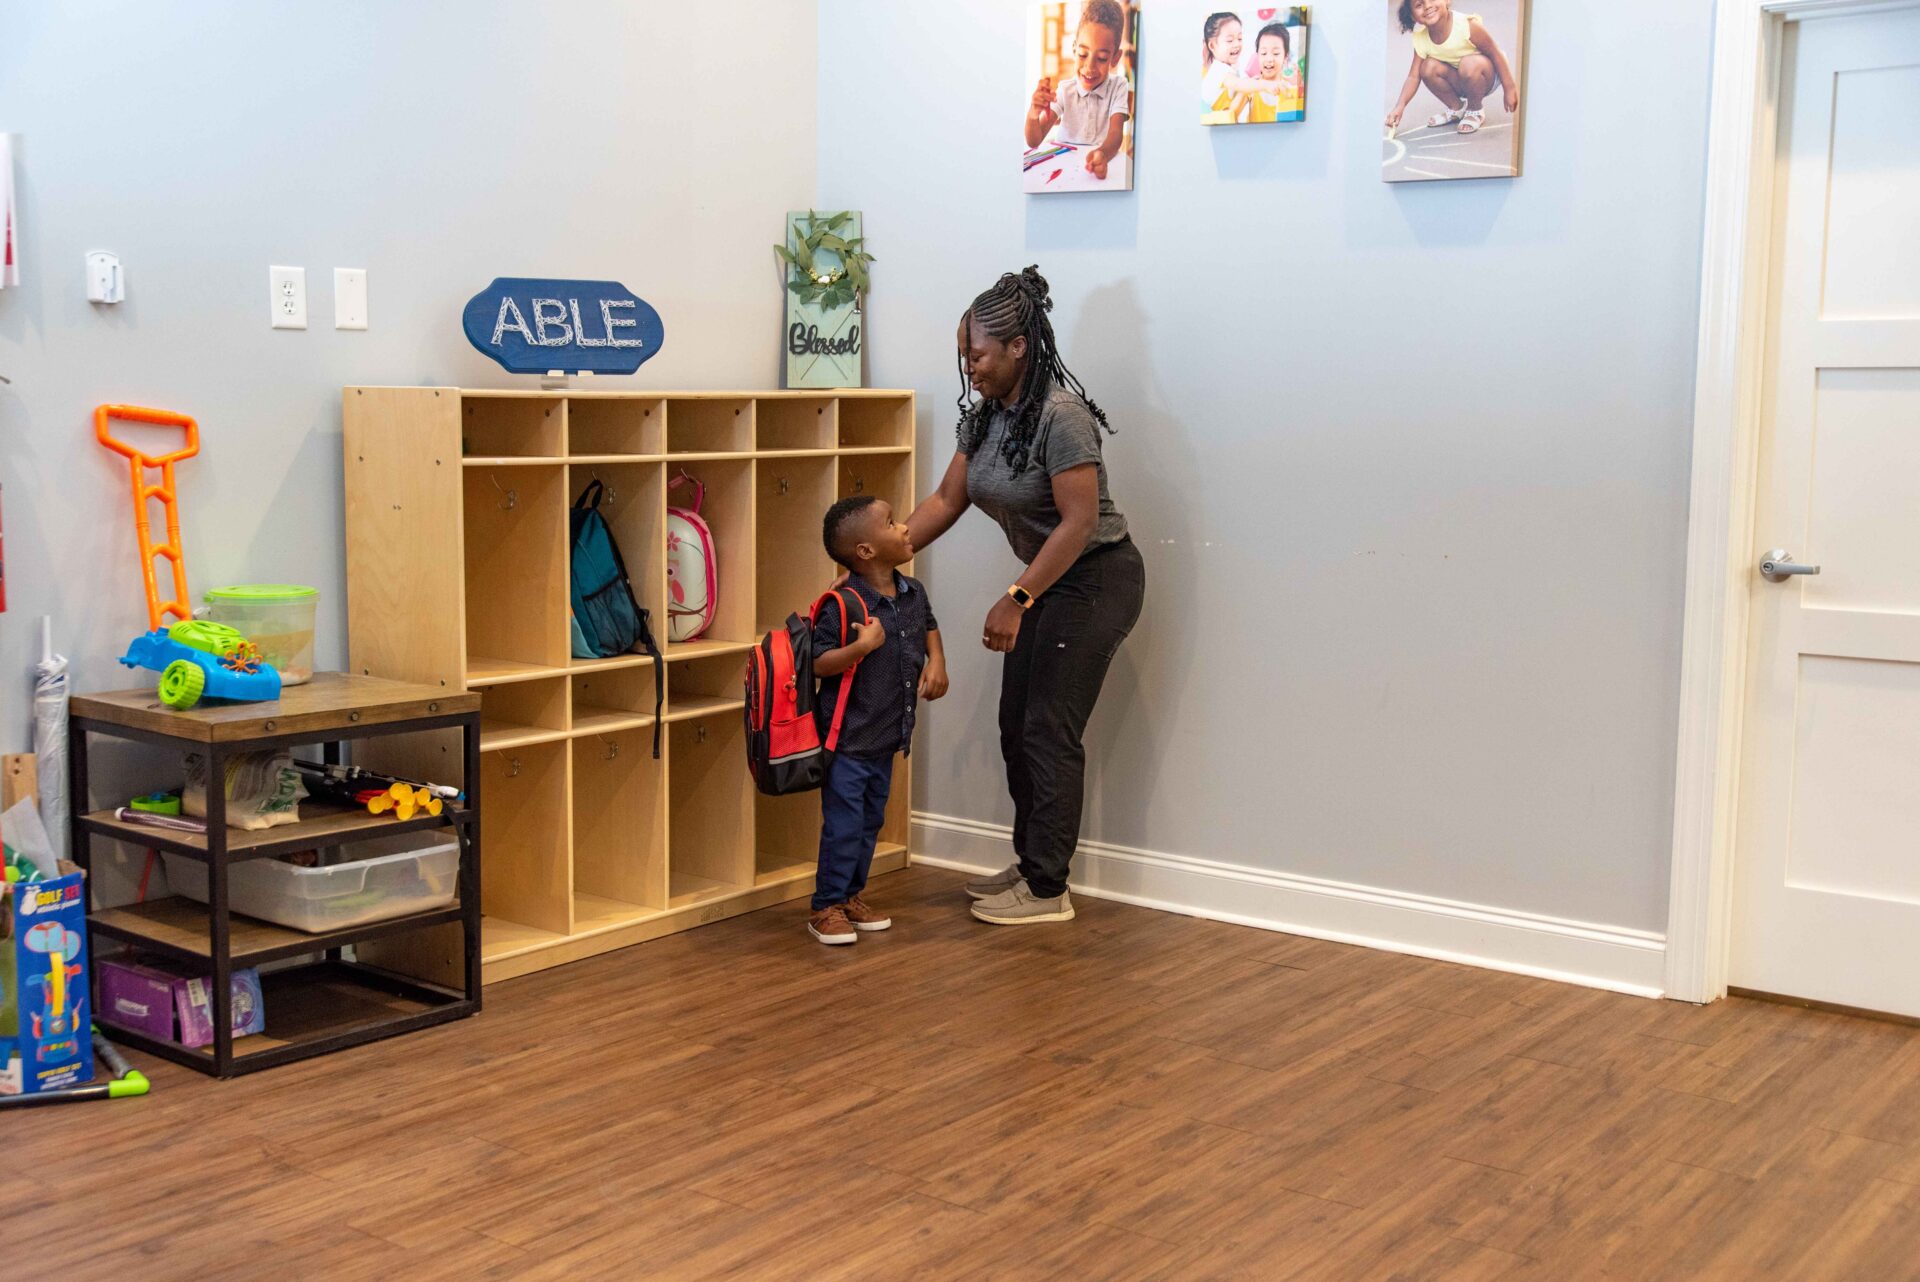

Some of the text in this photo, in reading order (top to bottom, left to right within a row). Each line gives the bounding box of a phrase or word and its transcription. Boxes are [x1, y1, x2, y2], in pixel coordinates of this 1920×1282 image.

[490, 296, 643, 347] ABLE
[789, 322, 861, 356] Blessed
[36, 888, 63, 908] GOLF
[64, 884, 81, 901] SET
